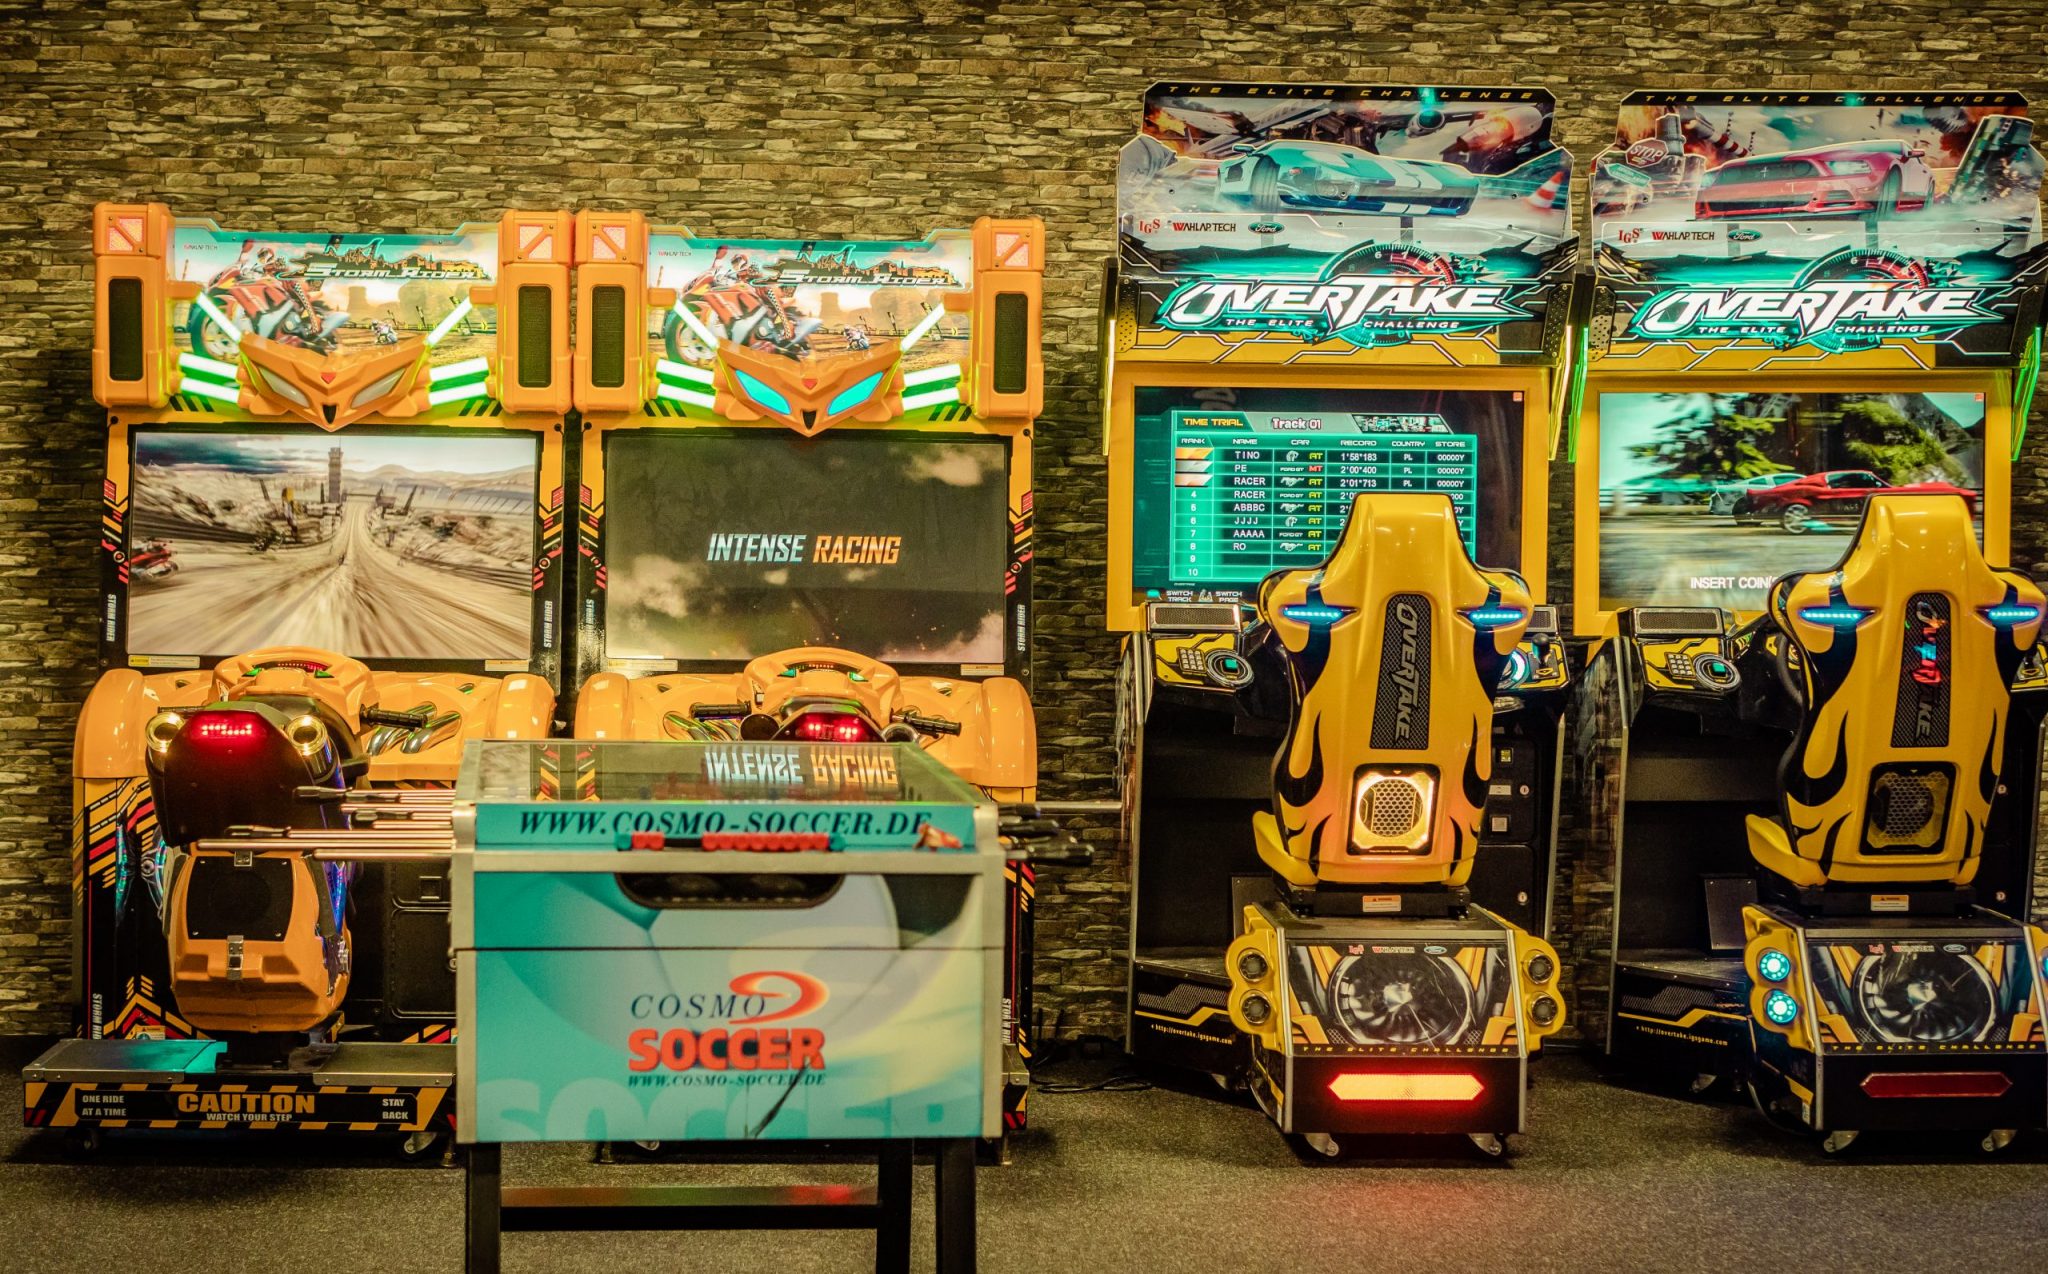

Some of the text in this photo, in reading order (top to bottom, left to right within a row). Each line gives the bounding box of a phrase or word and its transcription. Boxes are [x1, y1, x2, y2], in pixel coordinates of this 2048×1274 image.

[1169, 86, 1221, 95] THE
[1247, 87, 1335, 96] ELITE
[1644, 95, 2006, 104] THE ELITE CHALLENGE
[1630, 144, 1663, 159] STOP
[1255, 223, 1277, 232] Ford
[1733, 231, 1756, 241] Ford
[1226, 318, 1460, 329] THE ELITE CHALLENGE
[1698, 326, 1729, 334] THE
[1740, 326, 1786, 334] ELITE
[1183, 418, 1321, 430] TIME TRIAL Track 01
[1235, 451, 1260, 459] TINO
[1234, 464, 1247, 472] PE
[1234, 477, 1265, 485] RACER
[1234, 491, 1265, 499] RACER
[1234, 504, 1265, 512] ABBBC
[1234, 517, 1258, 525] JJJJ
[1308, 517, 1322, 525] AT
[1233, 530, 1265, 538] AAAAA
[1308, 530, 1322, 538] AT
[707, 533, 902, 564] INTENSE RACING
[1190, 555, 1196, 563] 9
[1690, 575, 1778, 589] INSERT COIN(
[1215, 590, 1242, 598] SWITCH
[631, 993, 766, 1019] COSMO
[92, 1025, 102, 1039] RID
[628, 1027, 826, 1072] SOCCER
[82, 1095, 125, 1104] ONE RIDE
[178, 1093, 315, 1113] CAUTION
[382, 1098, 405, 1106] STAY
[82, 1108, 127, 1117] AT A TIME
[382, 1111, 408, 1119] BACK
[206, 1113, 293, 1122] WATCH YOUR STEP
